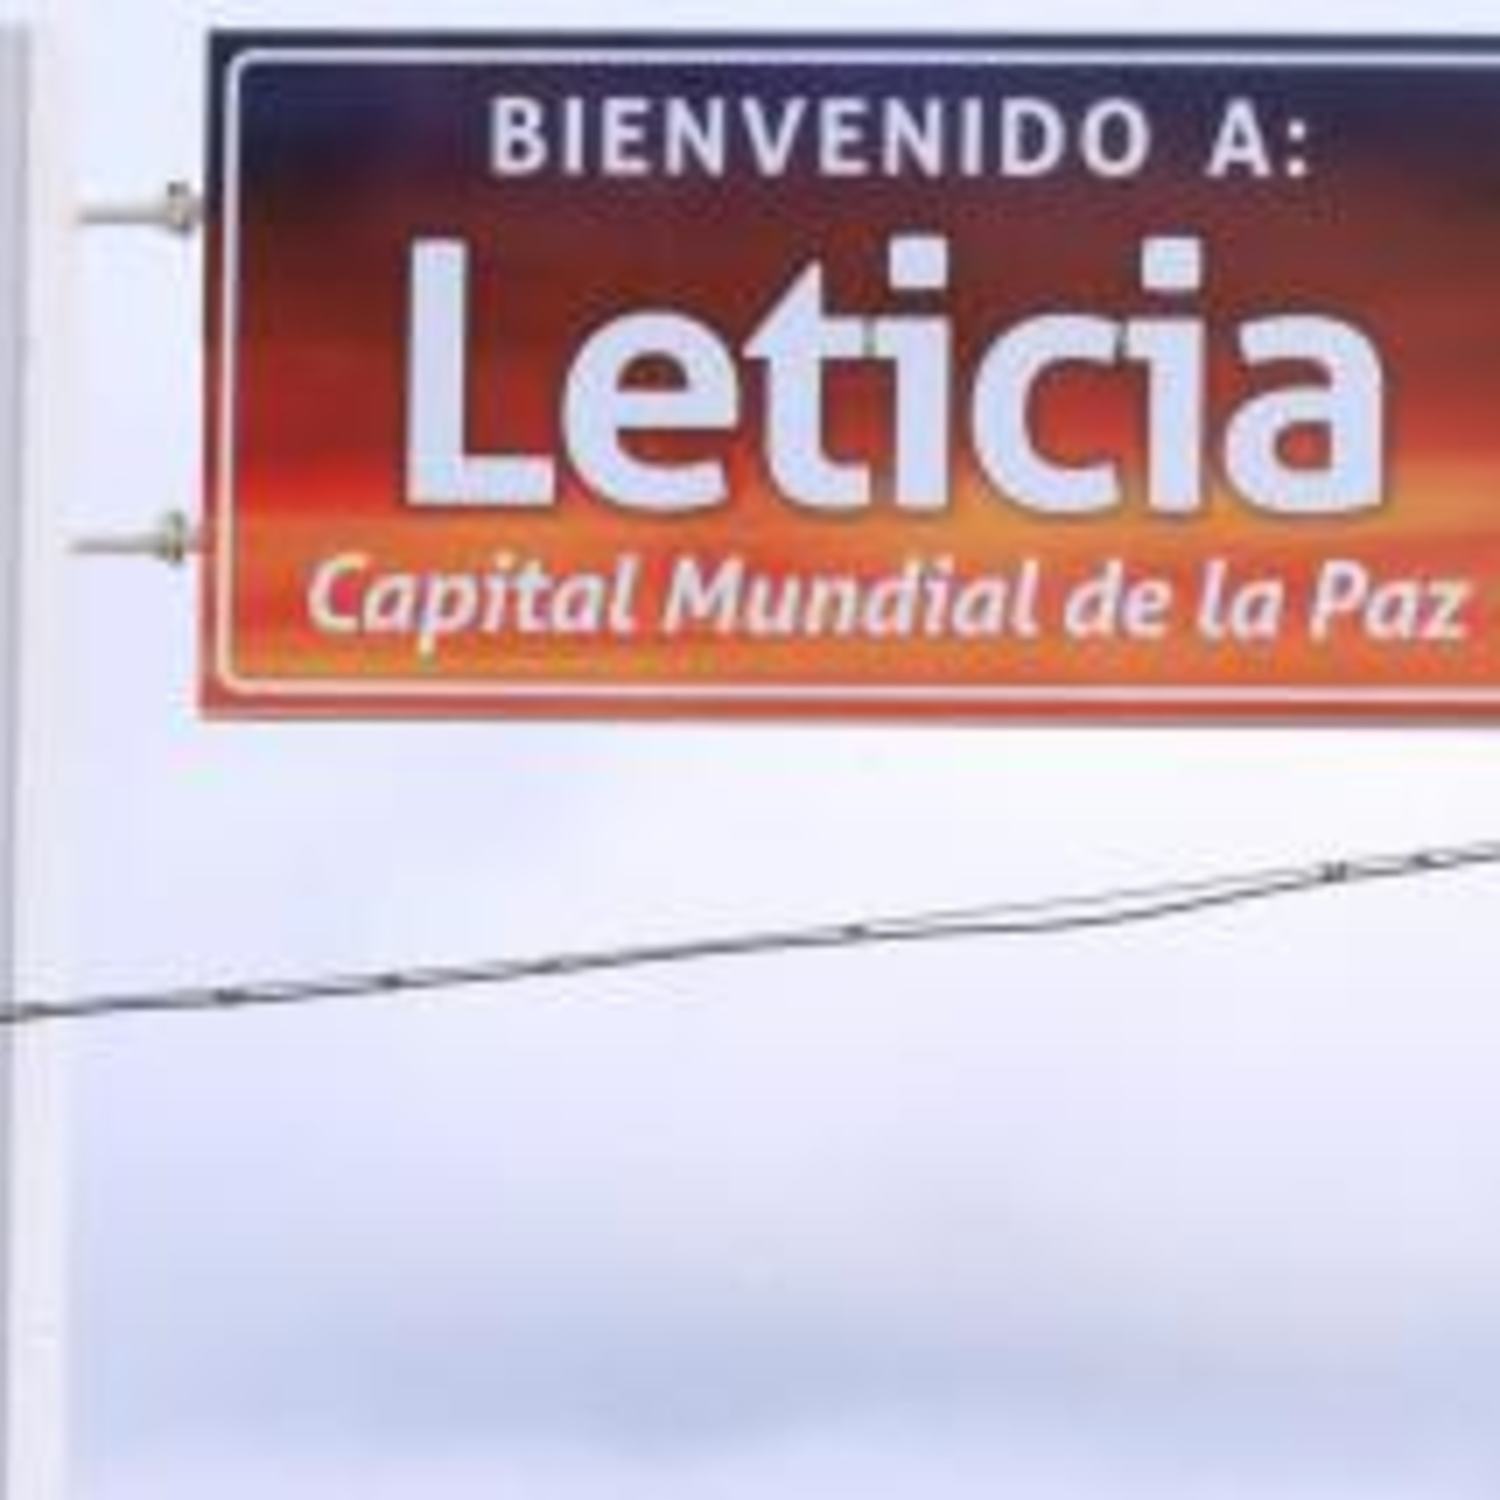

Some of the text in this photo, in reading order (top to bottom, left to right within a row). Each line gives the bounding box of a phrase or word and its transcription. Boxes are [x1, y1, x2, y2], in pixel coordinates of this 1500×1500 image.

[491, 96, 1312, 180] BIENVENIDO A:
[405, 234, 1387, 514] Leticia
[307, 553, 1472, 650] Capital Mundial de la Paz
